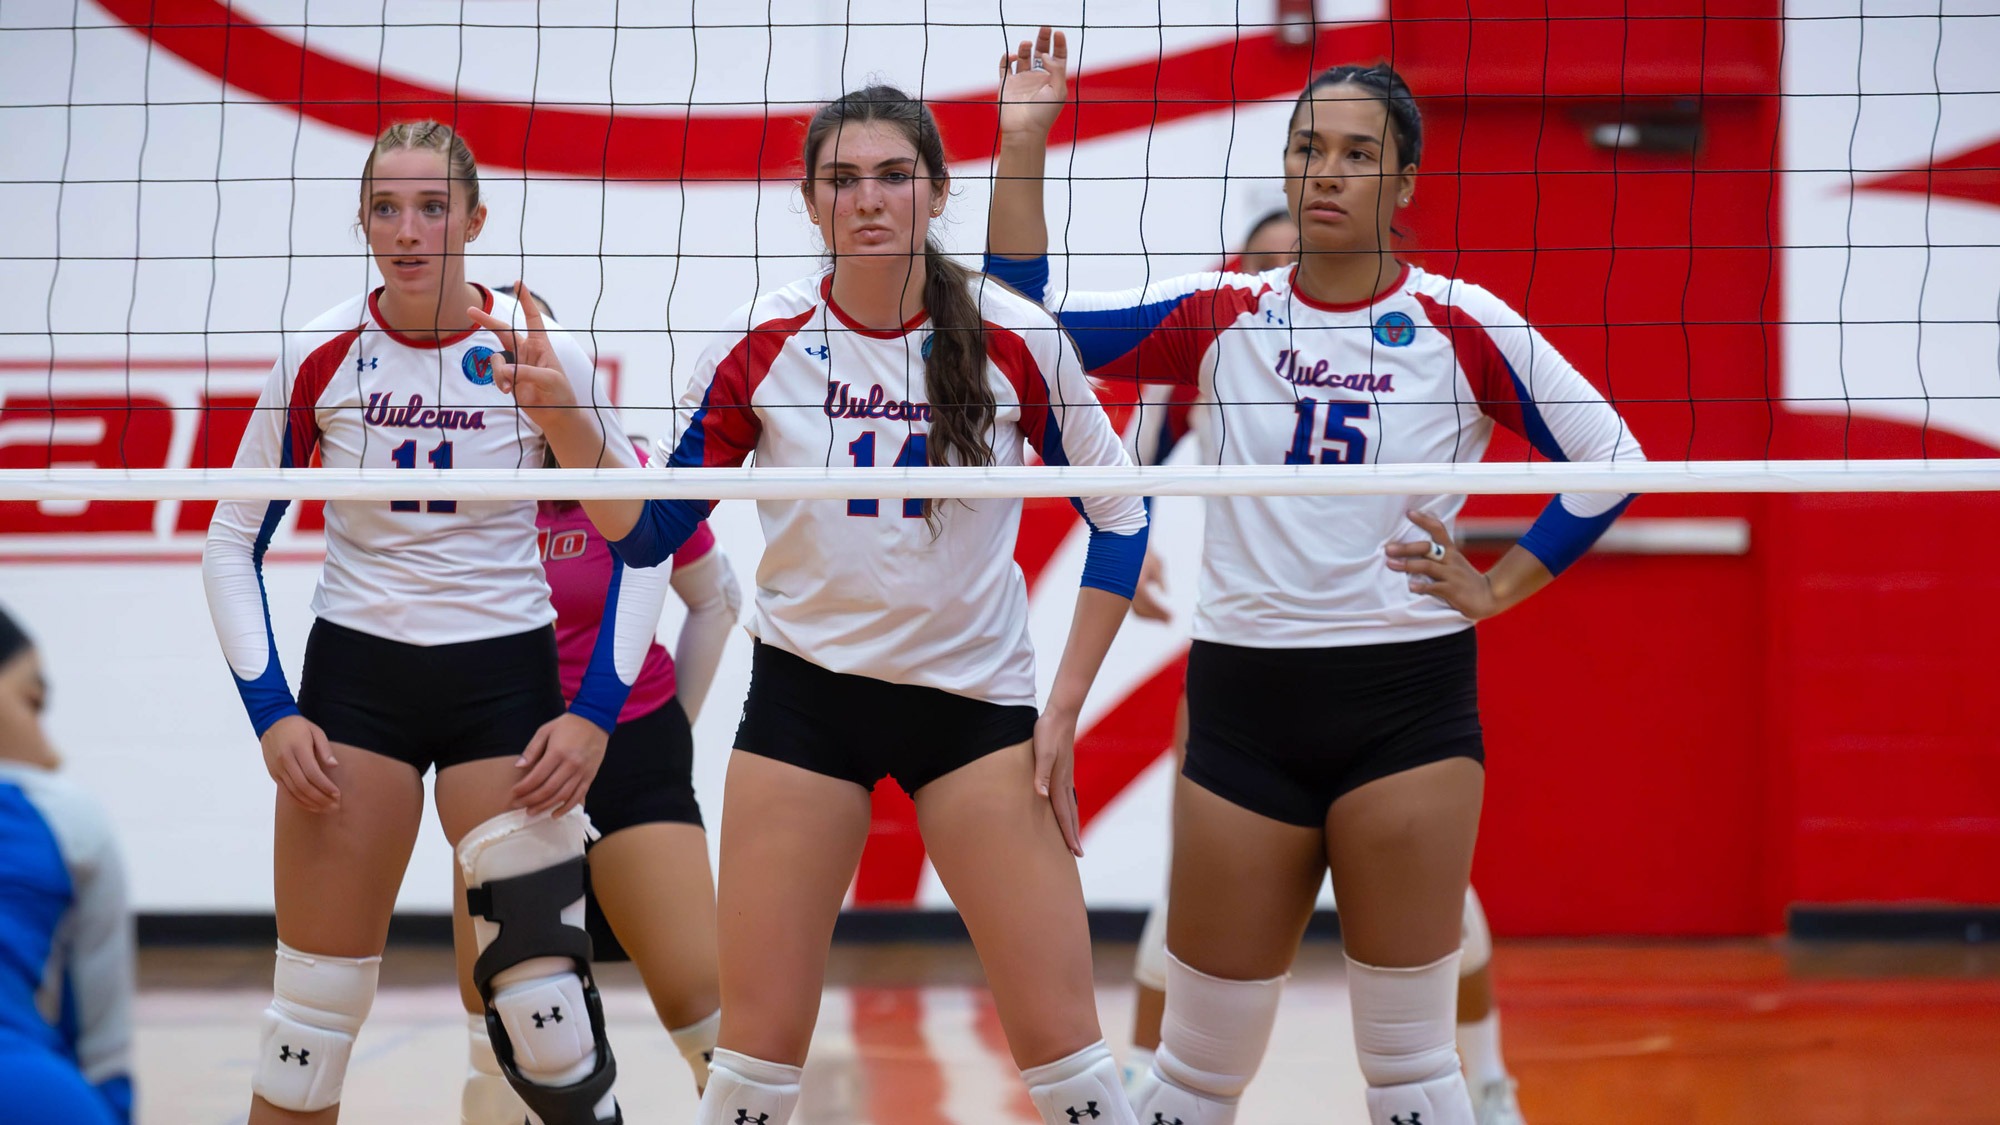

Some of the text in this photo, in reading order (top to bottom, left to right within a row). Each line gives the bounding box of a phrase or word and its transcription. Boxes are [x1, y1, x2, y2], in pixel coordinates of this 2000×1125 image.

[1275, 350, 1395, 393] Vulcans
[365, 392, 486, 430] Vulcans
[823, 381, 934, 423] Vulcan
[1284, 397, 1370, 465] 15
[391, 439, 457, 513] 11
